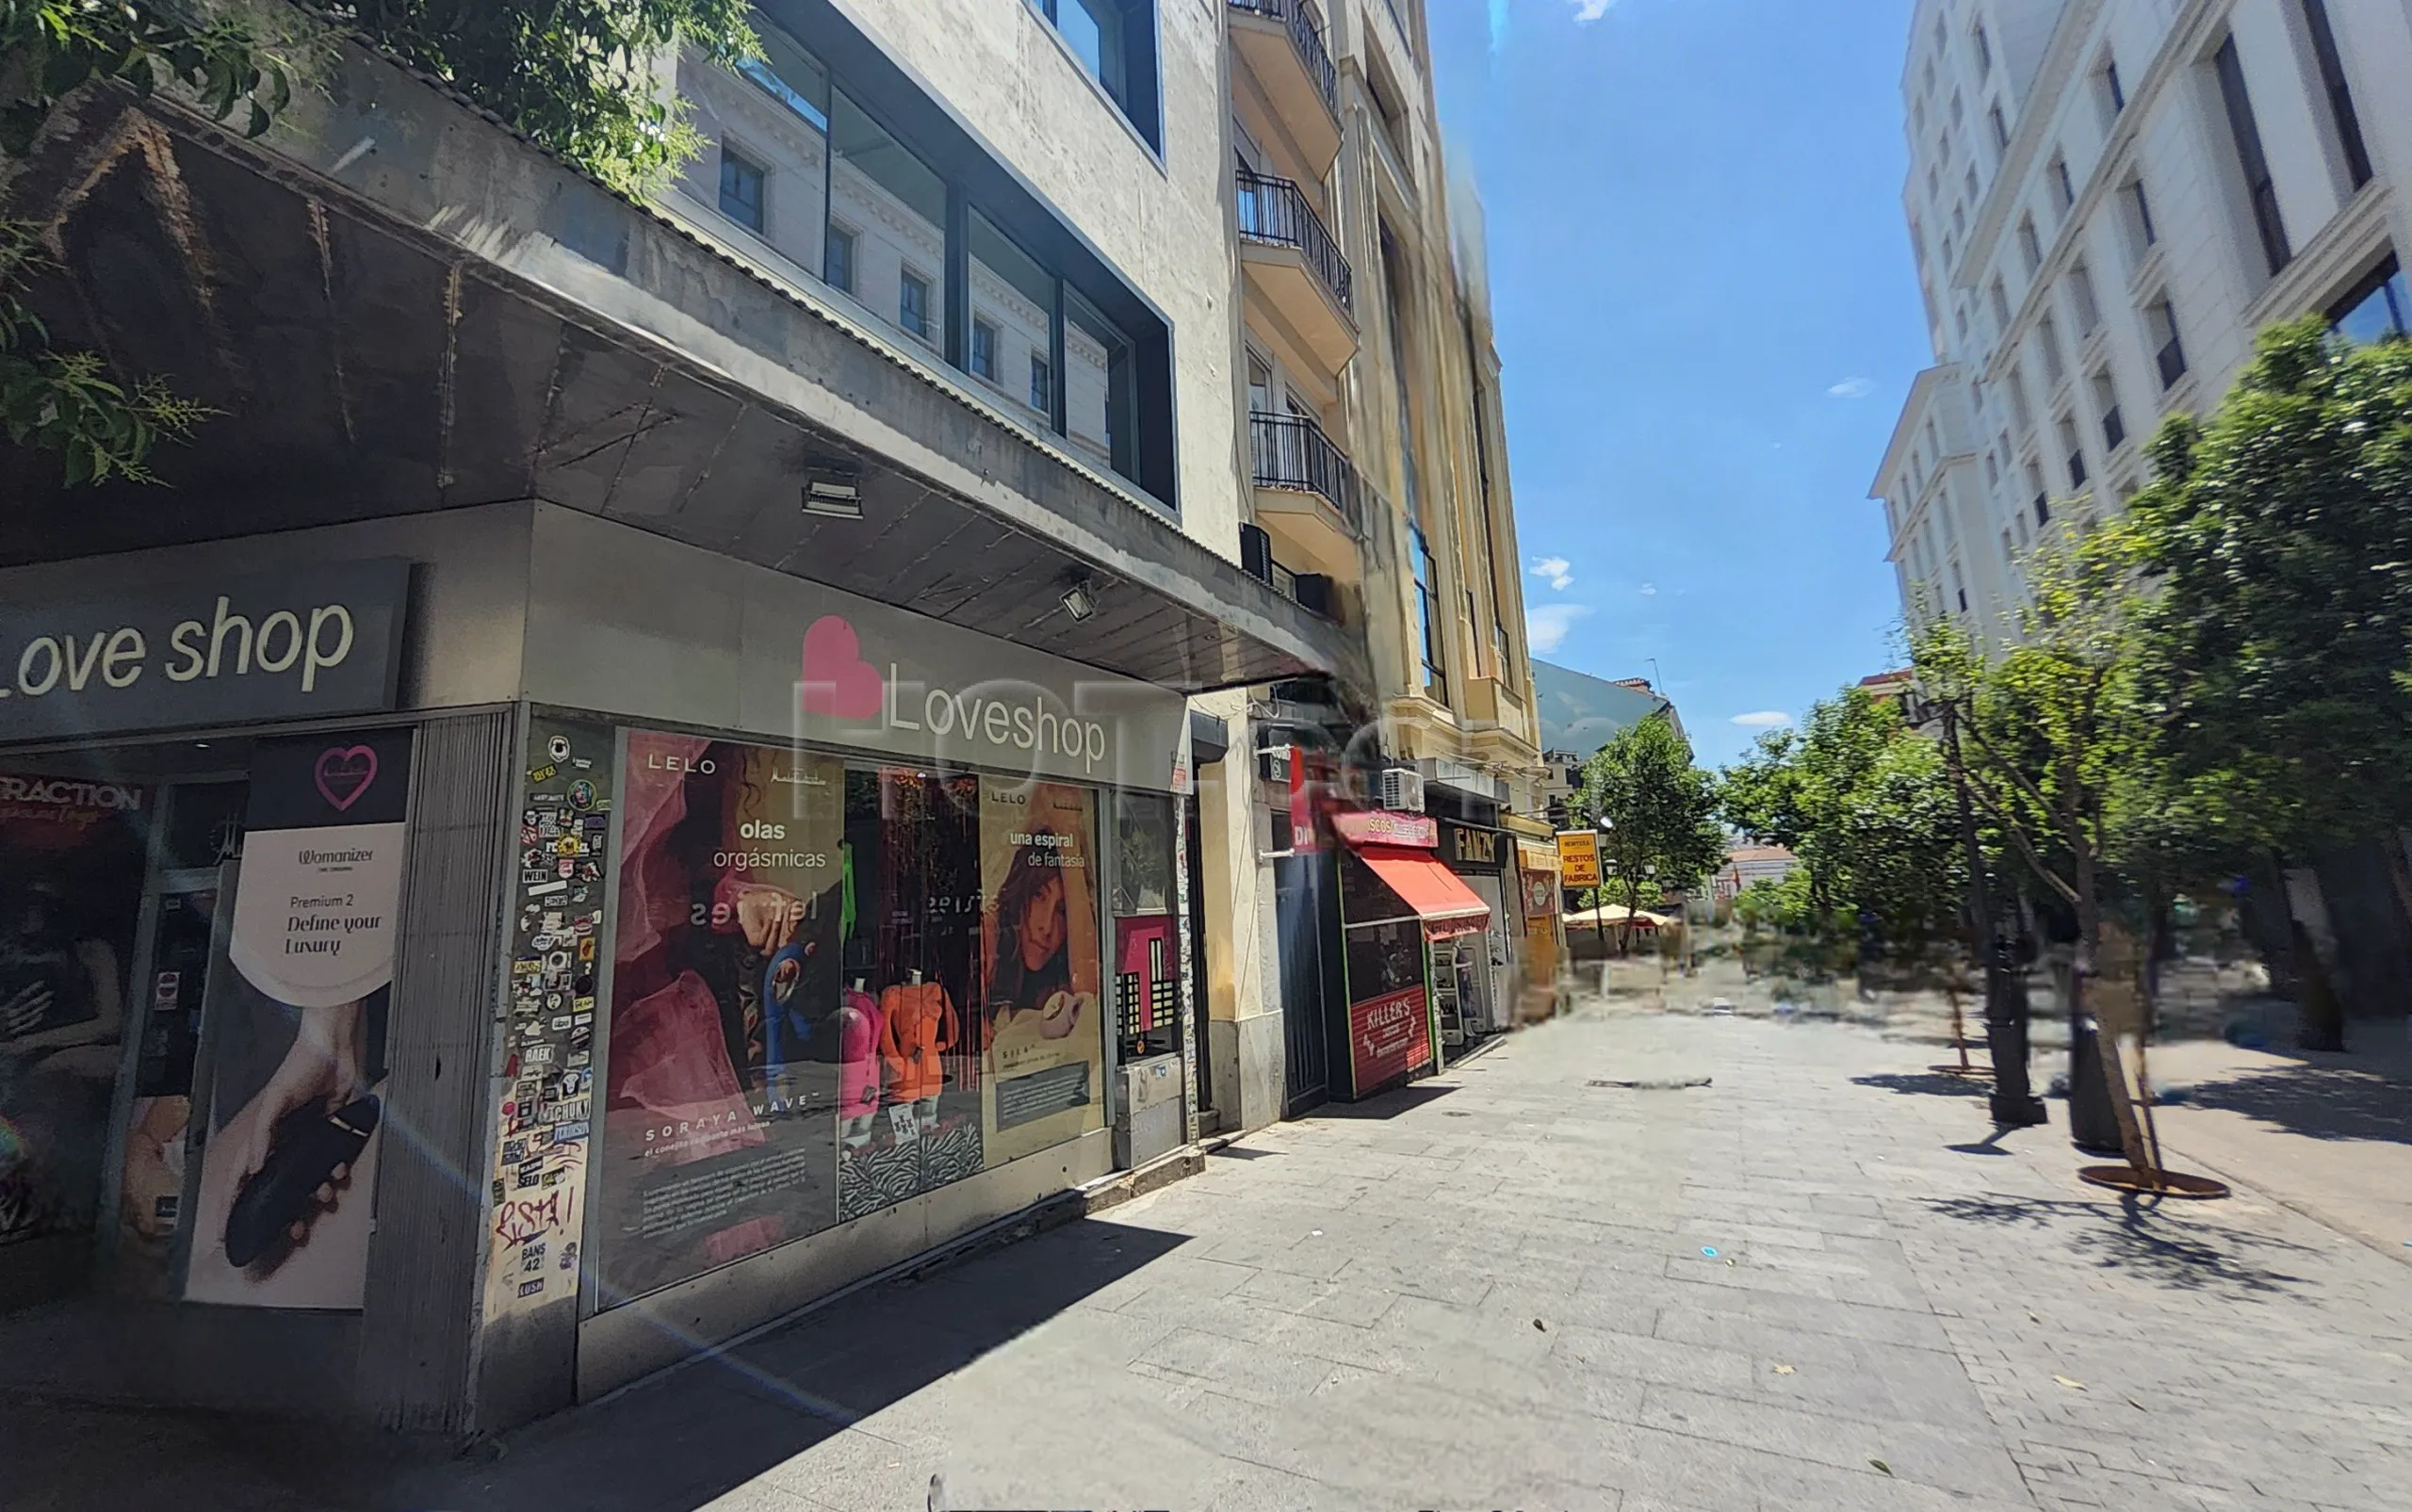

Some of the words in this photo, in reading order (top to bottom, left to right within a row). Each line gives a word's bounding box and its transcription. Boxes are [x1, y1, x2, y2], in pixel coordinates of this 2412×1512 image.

[165, 596, 353, 692] shop
[889, 662, 1105, 774] Loveshop
[648, 754, 716, 774] LELO
[991, 791, 1026, 805] LELO
[740, 819, 786, 839] olas
[1010, 833, 1033, 845] una
[1035, 832, 1073, 849] espiral
[299, 848, 373, 865] Womanizer
[713, 847, 826, 871] orgásmicas
[1028, 852, 1042, 866] de
[1563, 854, 1595, 863] RESTOS
[524, 870, 546, 882] WEIN
[1564, 873, 1598, 883] FABRICA
[290, 895, 343, 908] Premium
[346, 894, 353, 906] 2
[287, 915, 340, 932] Define
[344, 916, 383, 934] your
[285, 938, 341, 956] Luxury
[1366, 998, 1410, 1031] KILLERS
[645, 1112, 737, 1141] SORAYA
[523, 1258, 540, 1273] 42
